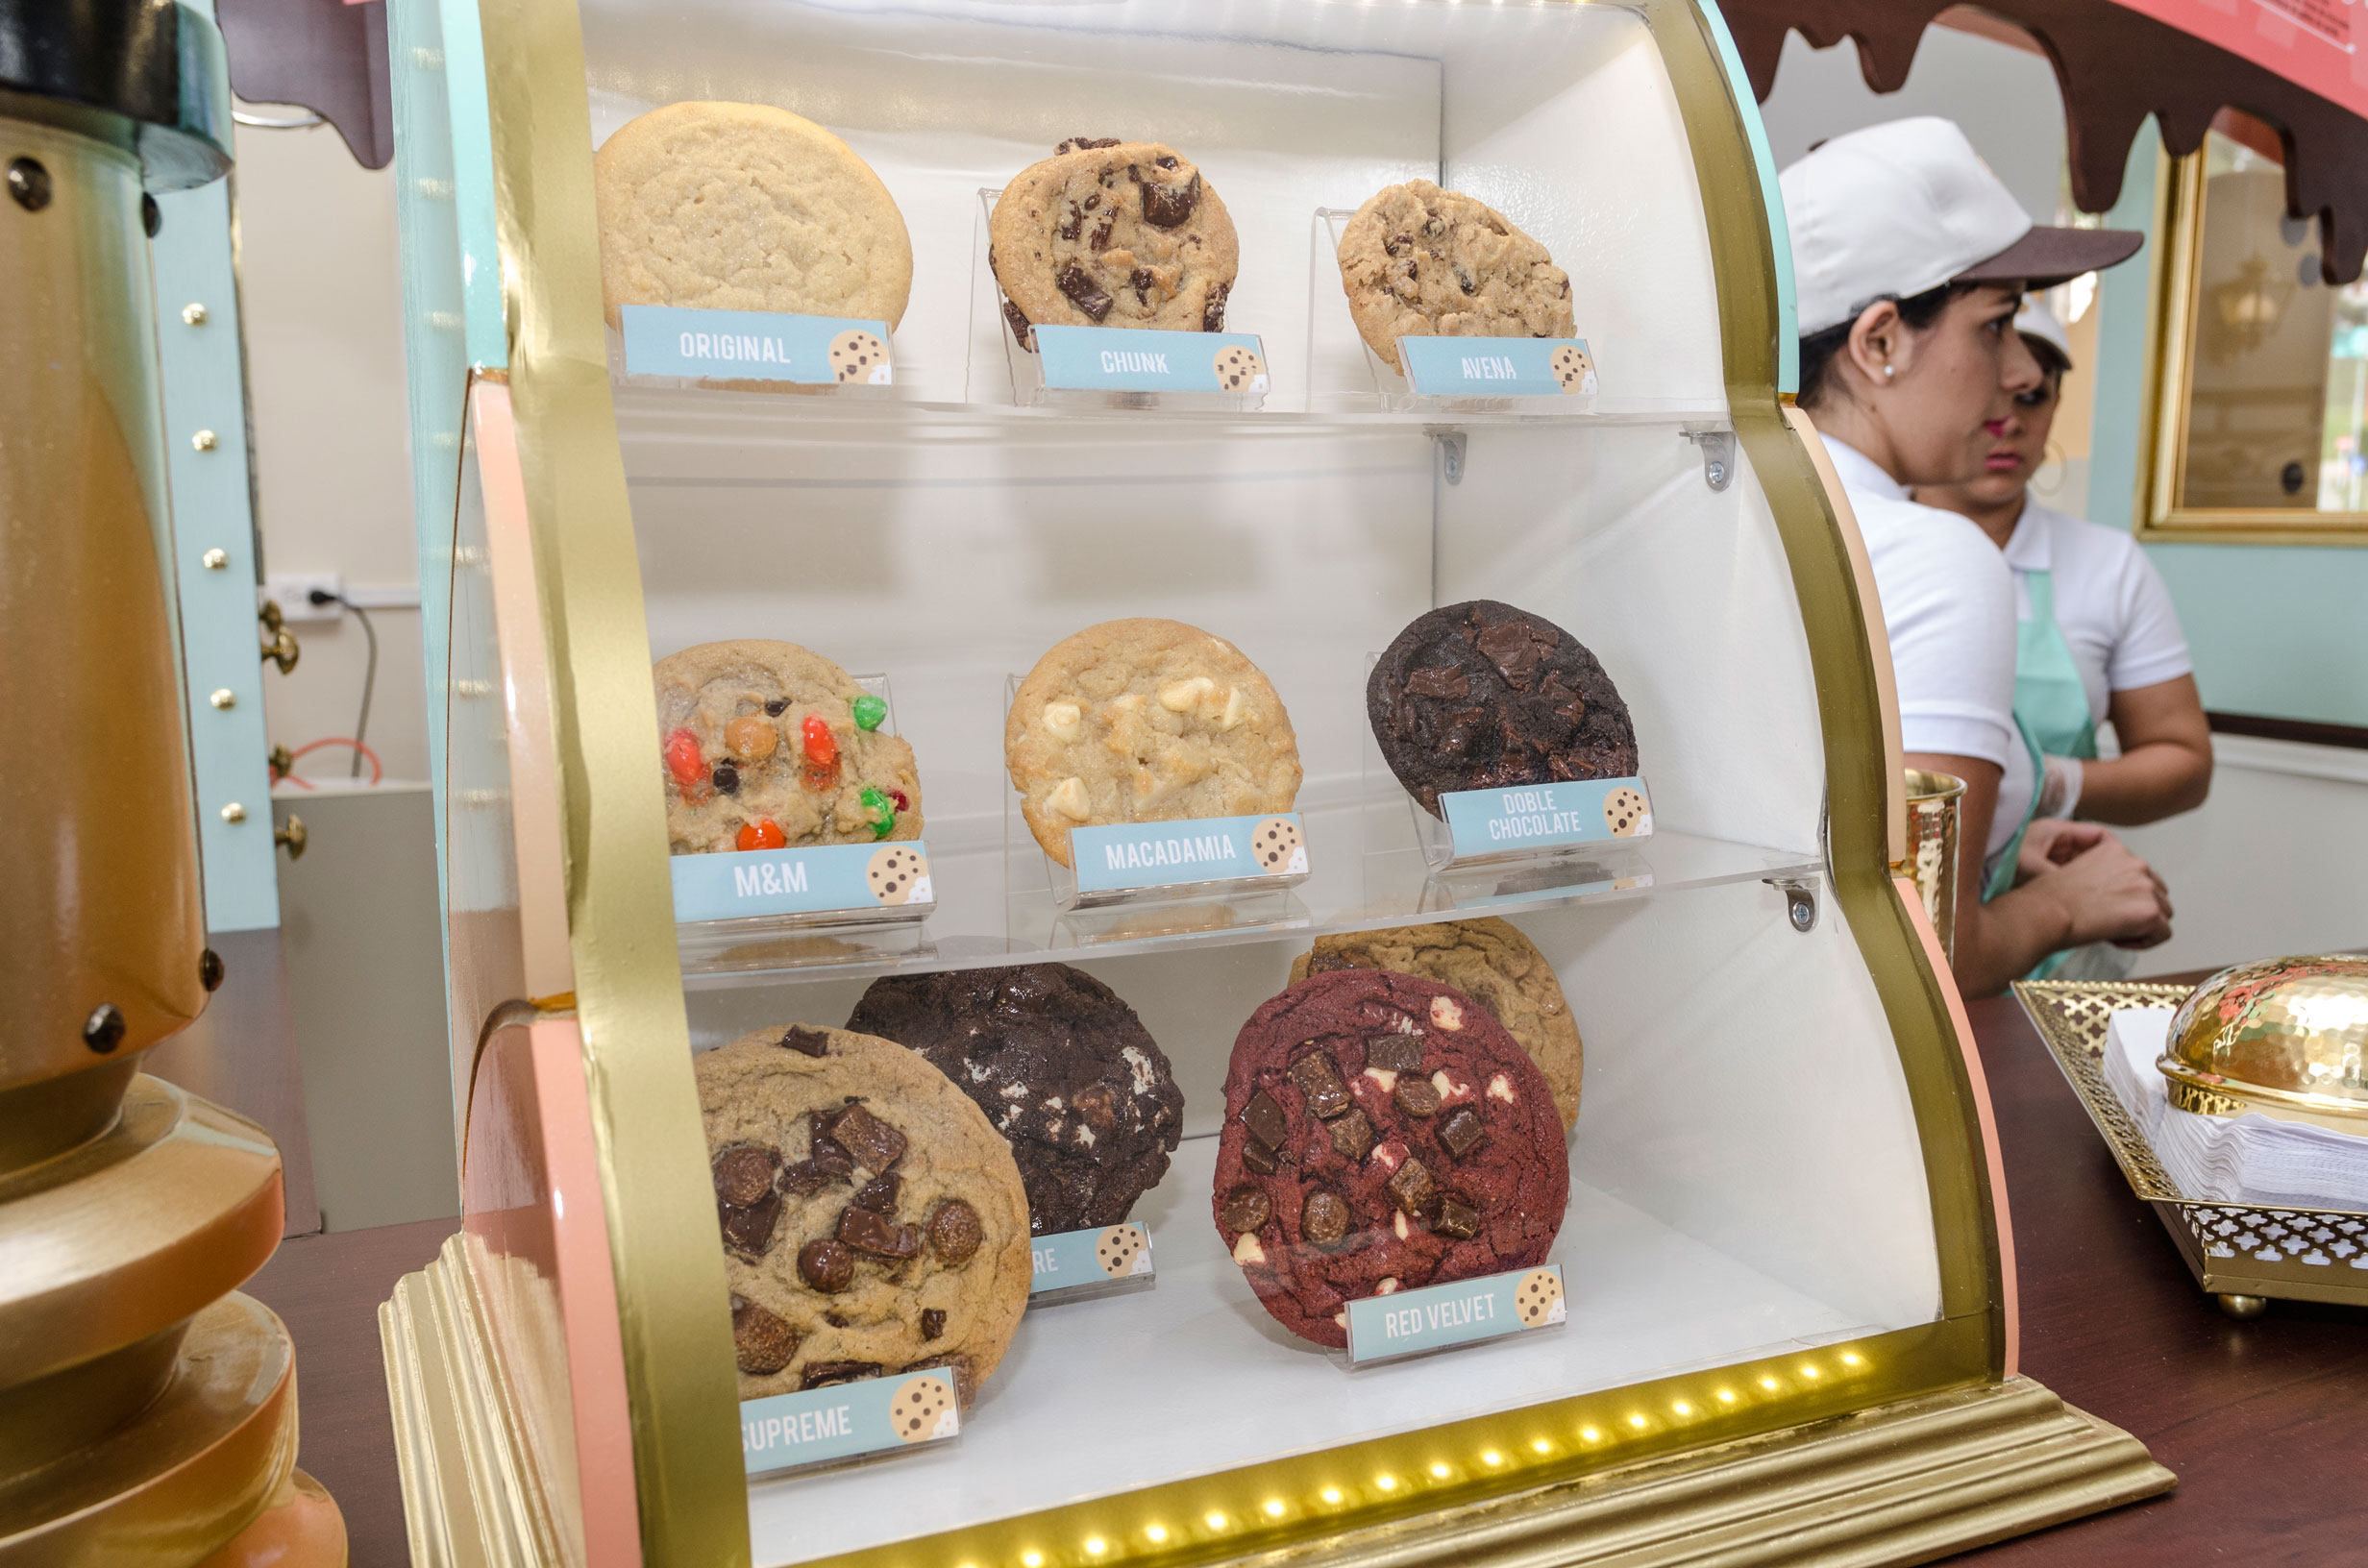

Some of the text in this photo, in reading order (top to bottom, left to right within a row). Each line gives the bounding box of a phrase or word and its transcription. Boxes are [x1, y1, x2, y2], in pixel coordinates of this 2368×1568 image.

[679, 331, 791, 363] ORIGINAL
[1100, 351, 1170, 374] CHUNK
[1462, 356, 1517, 380] AVENA
[1502, 790, 1557, 814] DOBLE
[1490, 811, 1582, 840] CHOCOLATE
[1105, 834, 1236, 870] MACADAMIA
[734, 862, 808, 897] M&M
[1385, 1293, 1494, 1338] RED VELVET
